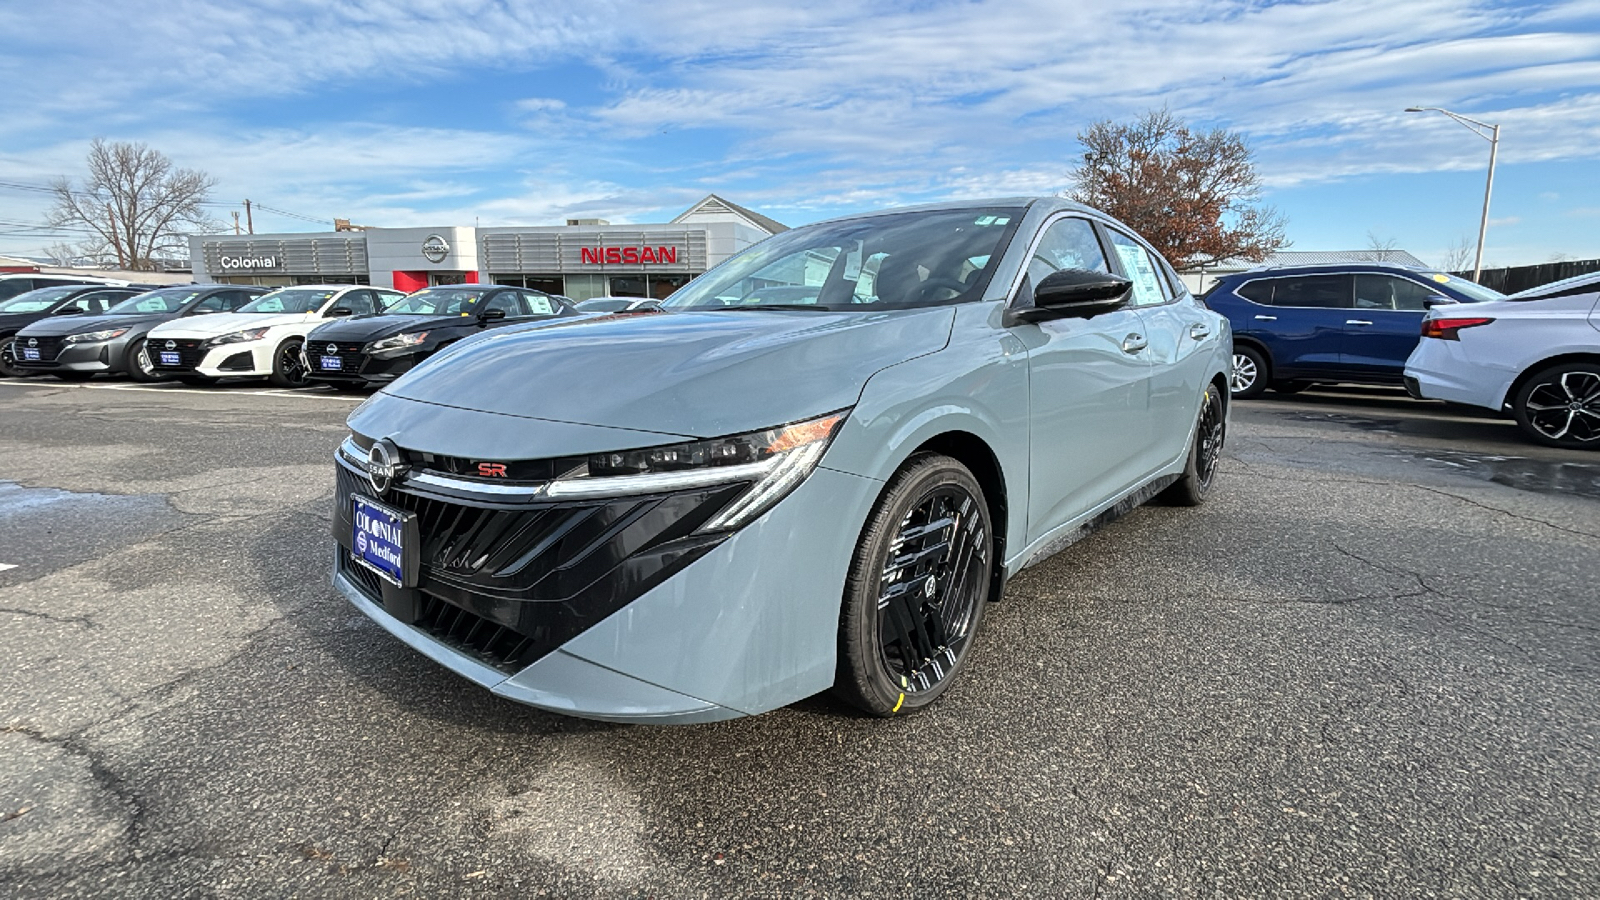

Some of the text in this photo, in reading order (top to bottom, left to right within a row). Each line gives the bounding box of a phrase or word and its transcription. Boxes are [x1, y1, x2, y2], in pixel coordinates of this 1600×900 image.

[221, 256, 276, 268] Colonial
[581, 246, 676, 264] NISSAN
[478, 462, 508, 477] SR
[356, 511, 402, 548] COLONIAL
[370, 540, 401, 568] Medford
